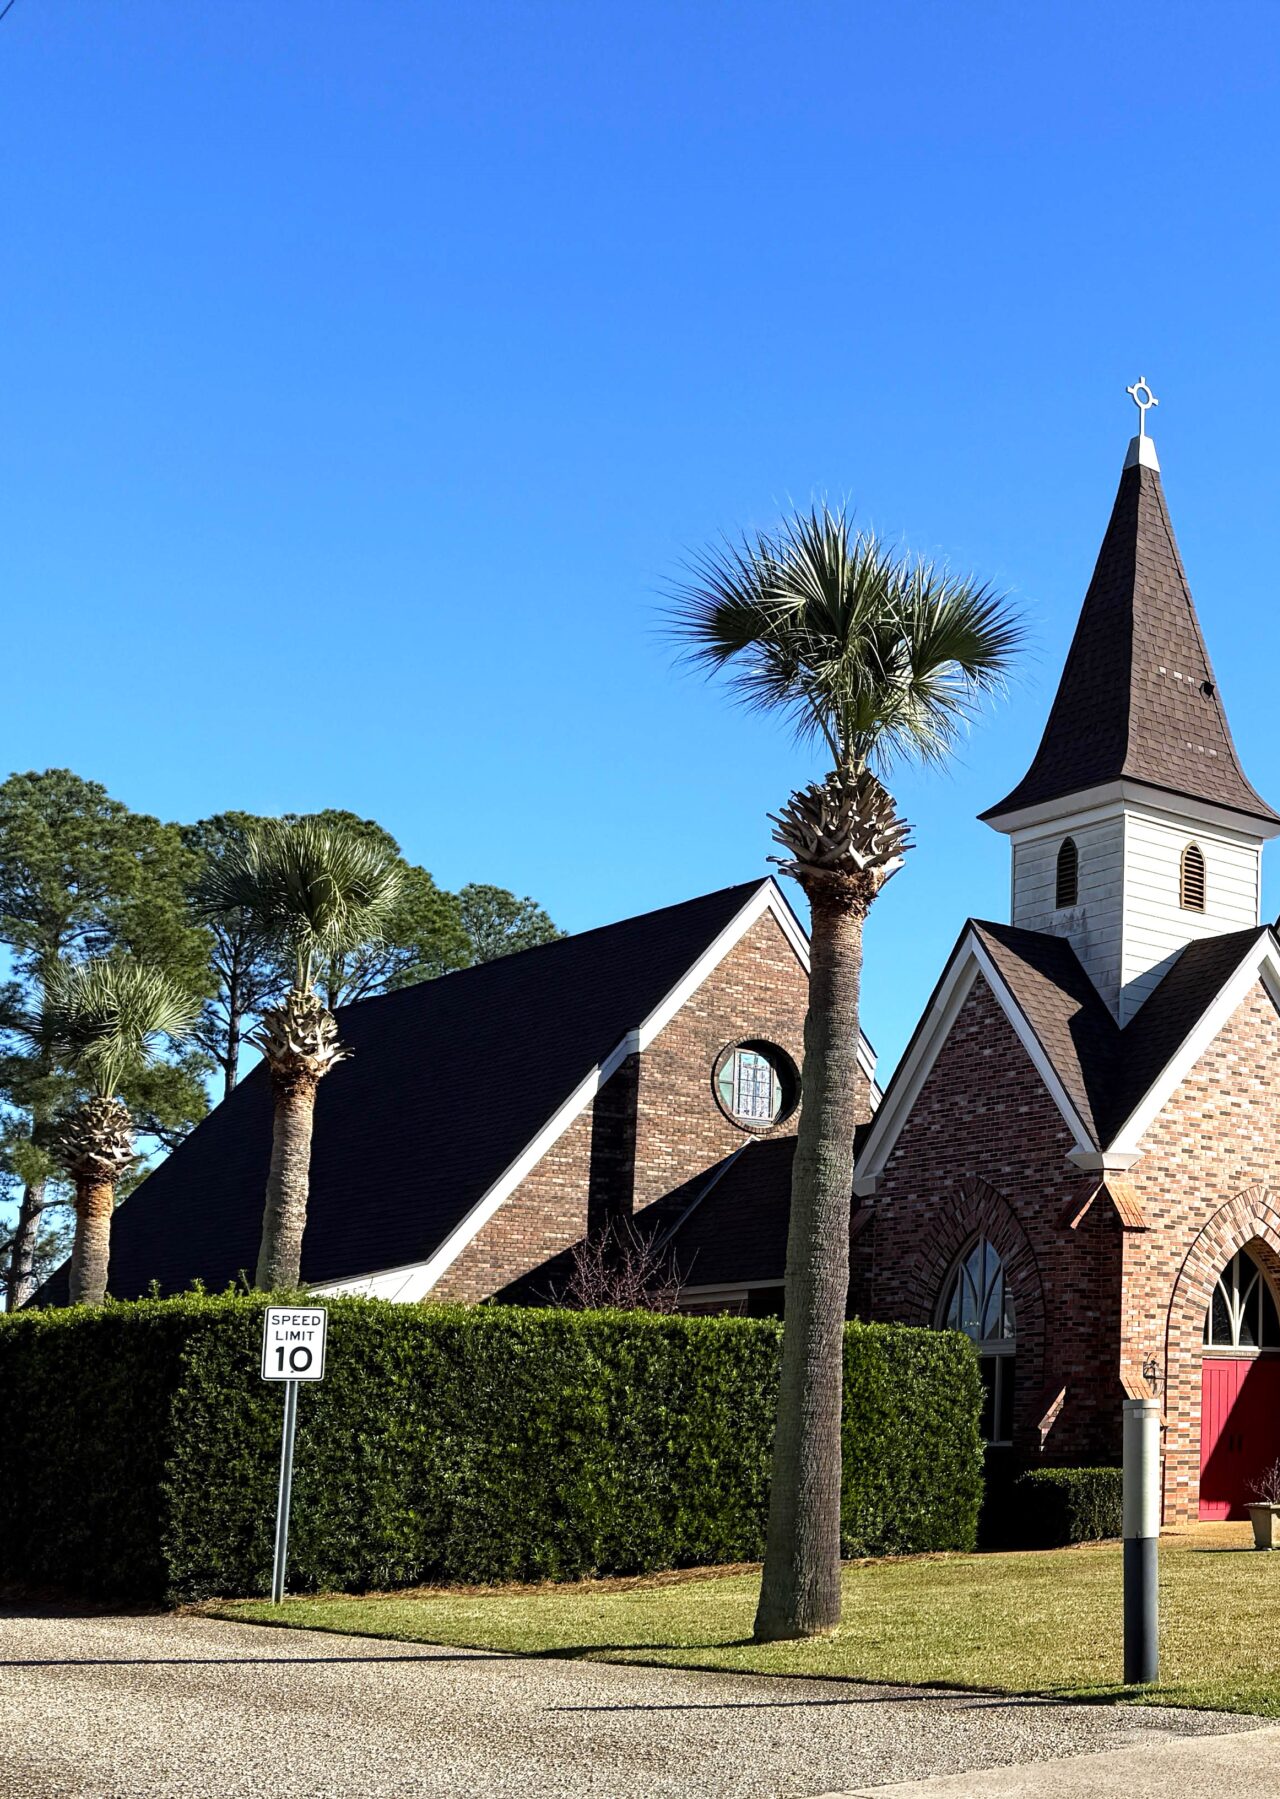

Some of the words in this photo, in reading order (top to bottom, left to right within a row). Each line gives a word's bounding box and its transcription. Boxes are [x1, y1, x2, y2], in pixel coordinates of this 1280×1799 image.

[271, 1314, 321, 1326] SPEED
[275, 1330, 315, 1341] LIMIT
[275, 1346, 313, 1372] 10
